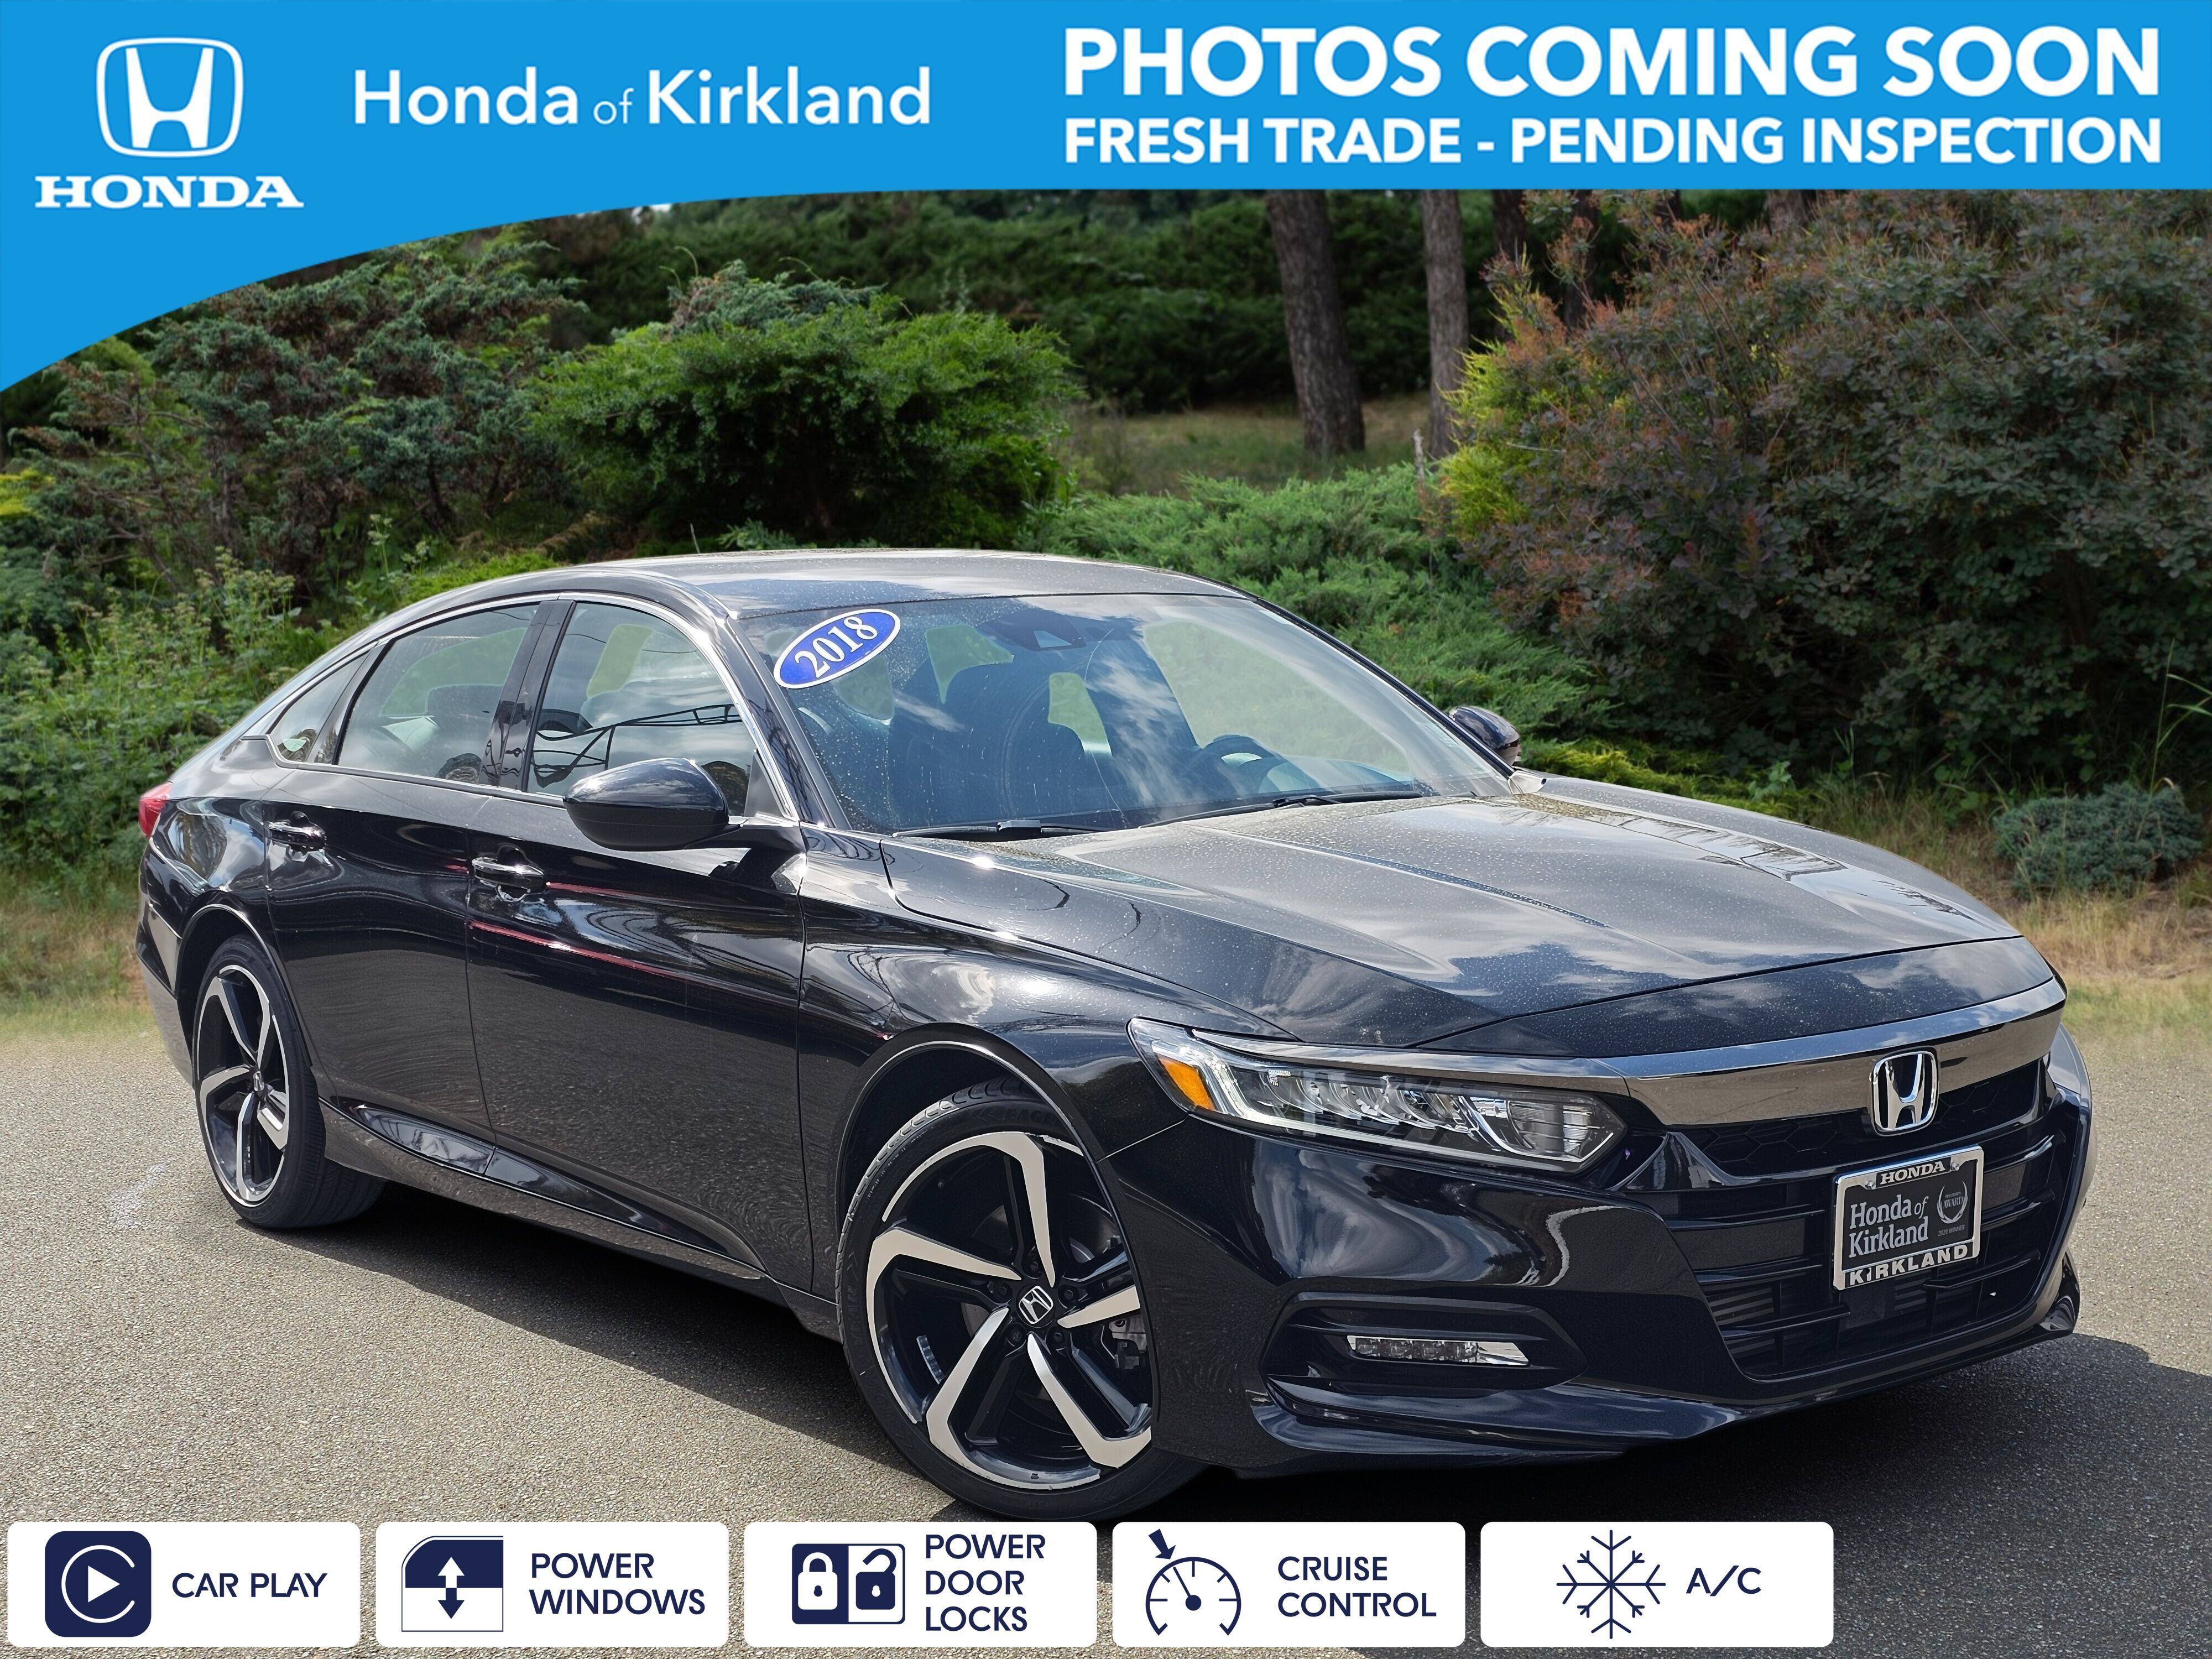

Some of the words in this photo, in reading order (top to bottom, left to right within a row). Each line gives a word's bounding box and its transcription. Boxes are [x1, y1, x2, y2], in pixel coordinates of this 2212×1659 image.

[795, 615, 878, 679] 2018
[1880, 1161, 1945, 1185] HONDA
[1849, 1194, 1912, 1229] Honda
[1914, 1196, 1929, 1219] of
[1849, 1216, 1929, 1258] Kirkland
[1850, 1244, 1968, 1285] KIRKLAND
